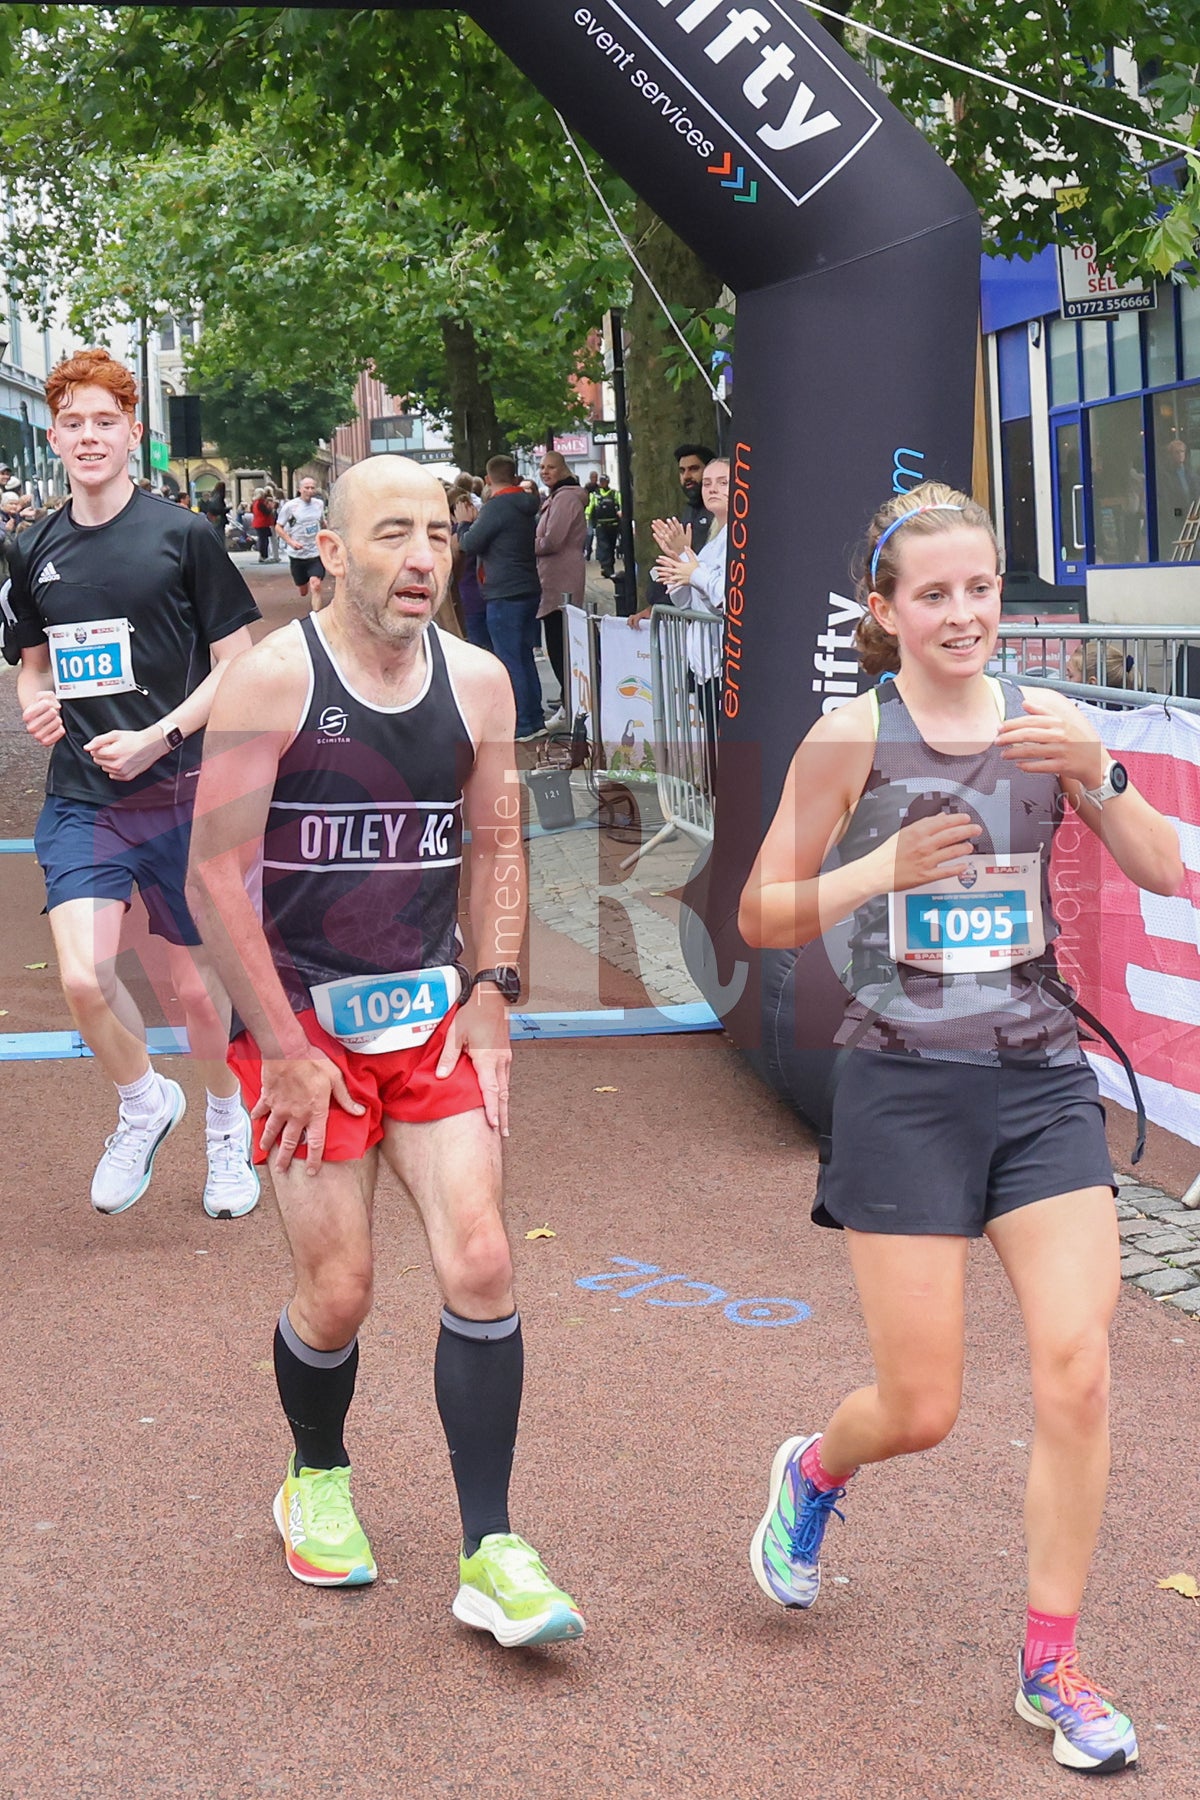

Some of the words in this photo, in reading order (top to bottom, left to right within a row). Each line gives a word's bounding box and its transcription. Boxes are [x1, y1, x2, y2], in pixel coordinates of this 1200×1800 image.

[573, 7, 635, 71] event
[630, 68, 715, 158] services
[1088, 277, 1125, 293] SEL
[1068, 301, 1105, 315] 01772
[1106, 295, 1150, 310] 556666
[723, 441, 751, 719] entries.com
[60, 653, 113, 679] 1018
[316, 737, 351, 745] SCIMITAR
[544, 790, 560, 800] 121
[301, 814, 406, 860] OTLEY
[418, 813, 454, 857] AC
[993, 866, 1020, 874] SPAR
[922, 905, 1013, 943] 1095
[998, 949, 1024, 957] SPAR
[346, 983, 435, 1027] 1094
